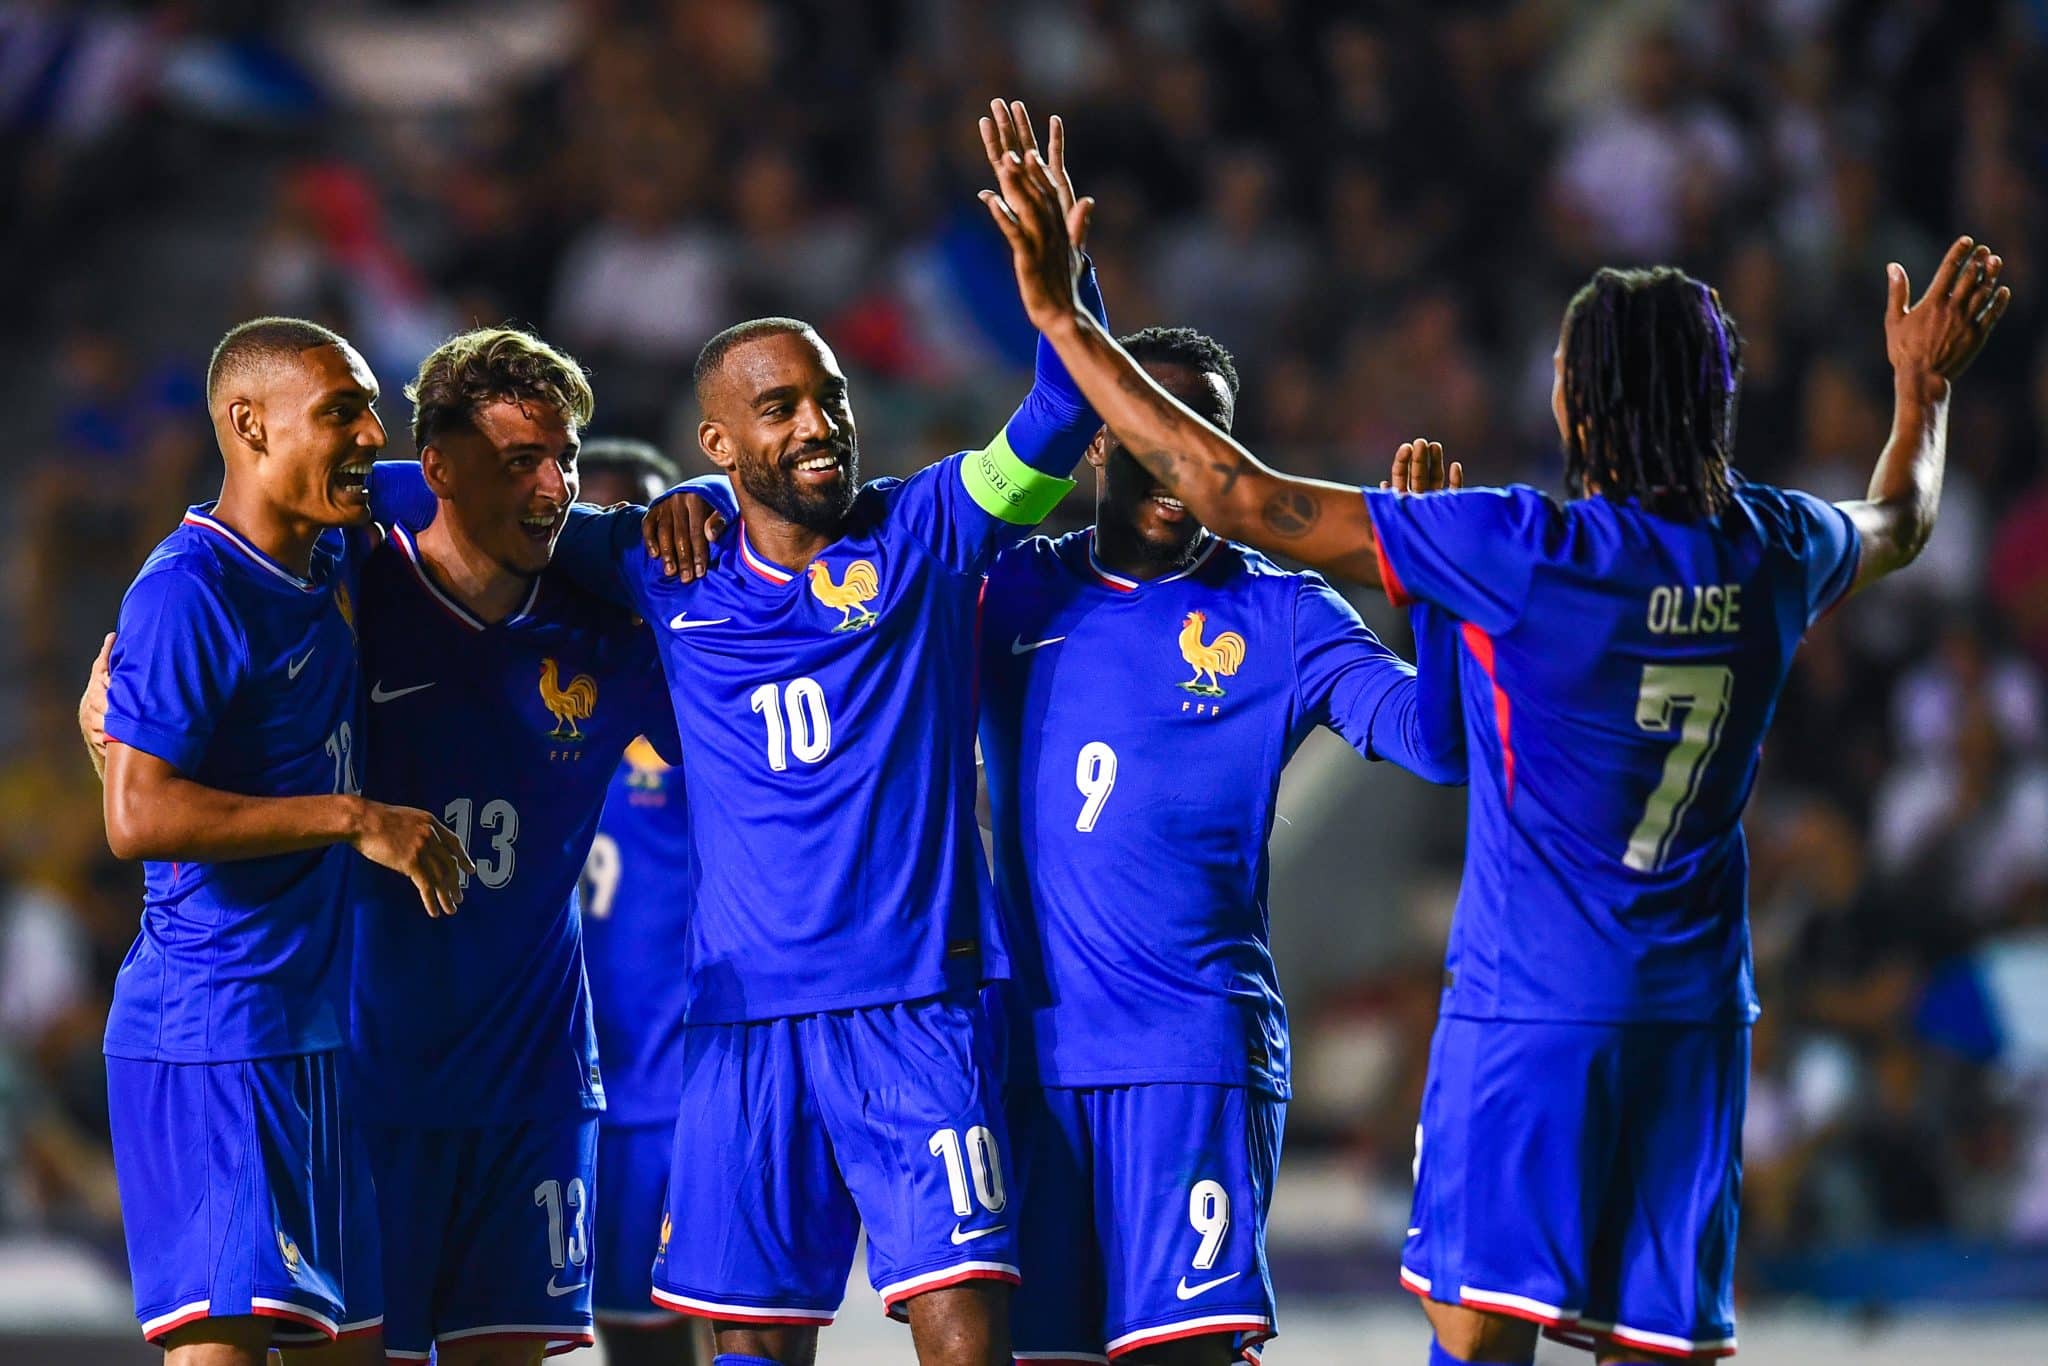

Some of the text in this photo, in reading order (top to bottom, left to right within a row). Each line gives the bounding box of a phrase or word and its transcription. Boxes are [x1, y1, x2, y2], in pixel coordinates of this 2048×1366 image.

[981, 451, 1008, 491] RESP
[1647, 585, 1741, 634] OLISE
[751, 677, 831, 772] 10
[1622, 665, 1734, 872] 7
[1075, 741, 1118, 833] 9
[444, 798, 519, 889] 13
[928, 1125, 1007, 1217] 10
[534, 1178, 588, 1269] 13
[1189, 1179, 1230, 1270] 9
